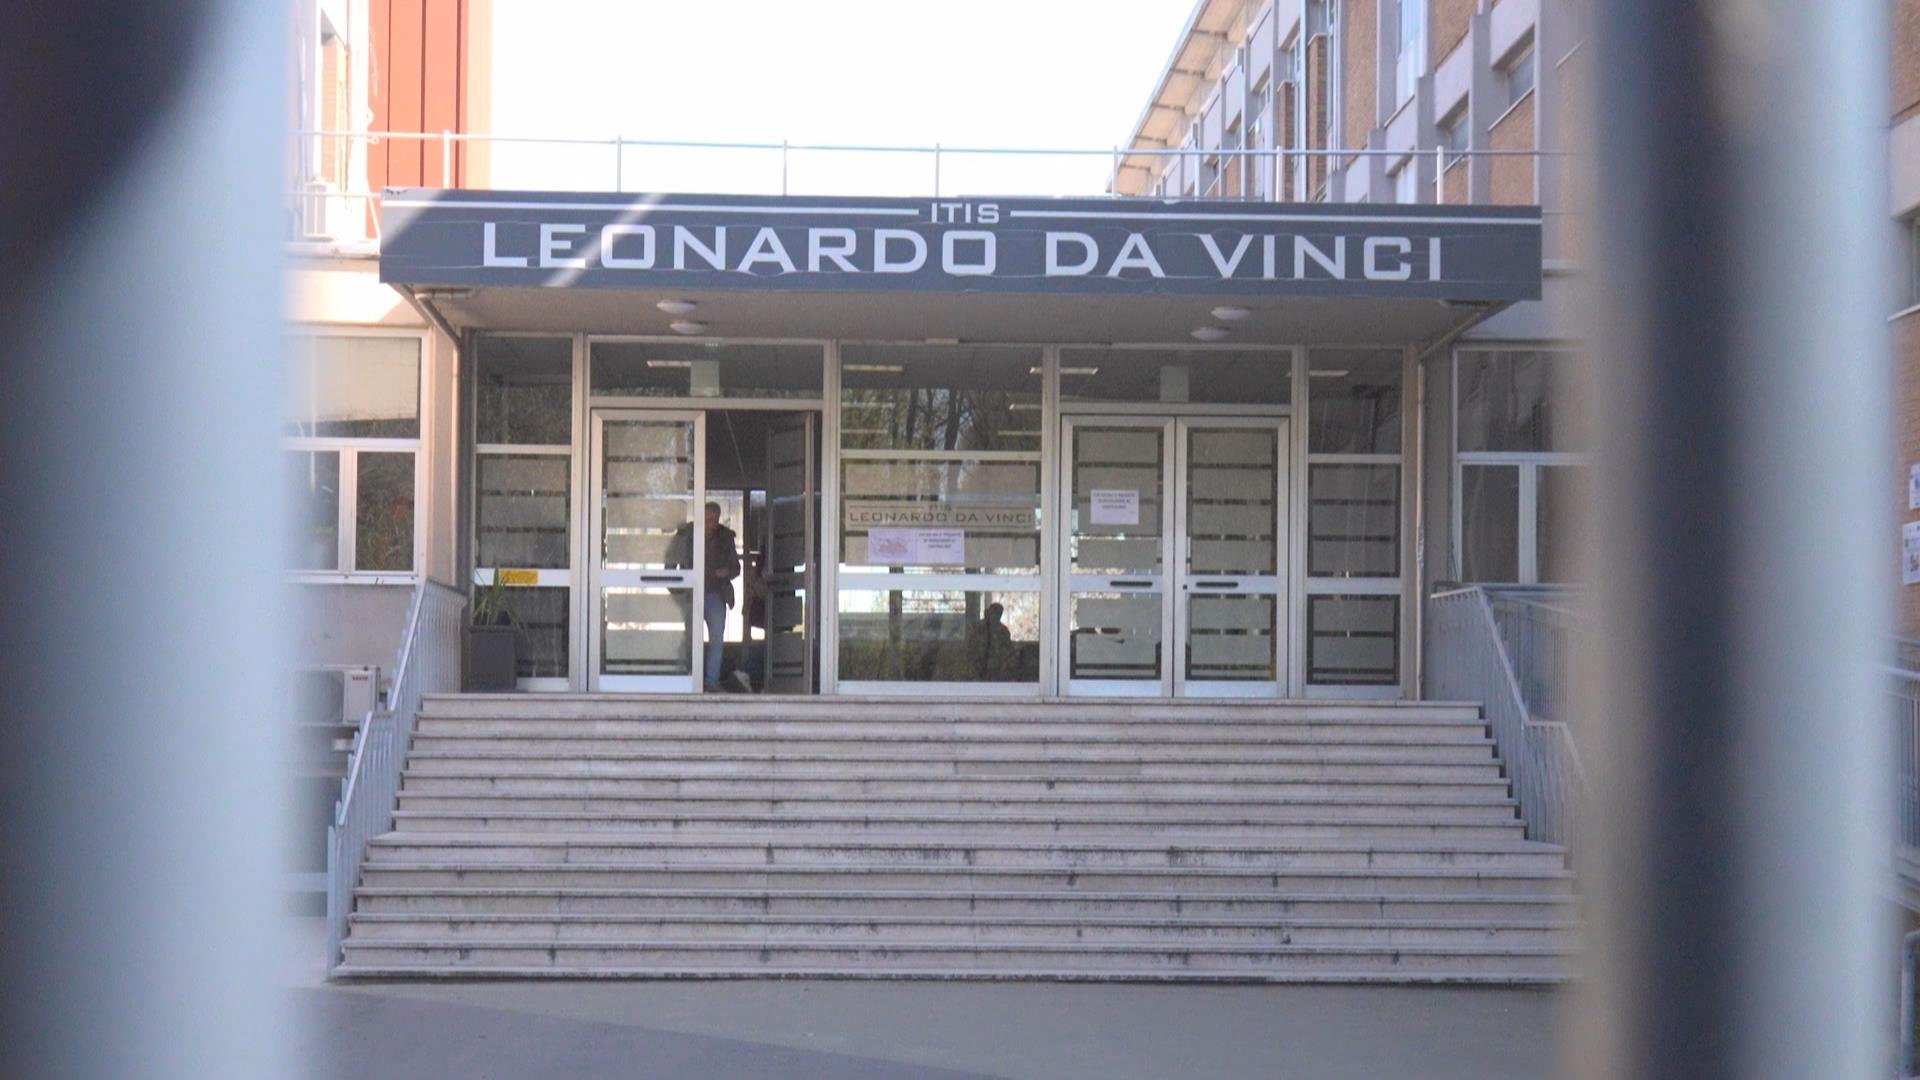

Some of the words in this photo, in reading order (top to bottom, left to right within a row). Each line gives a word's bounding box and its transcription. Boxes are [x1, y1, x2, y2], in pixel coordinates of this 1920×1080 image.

[931, 203, 999, 223] ITIS
[484, 222, 996, 275] LEONARDO
[1046, 231, 1166, 278] DA
[1198, 234, 1441, 281] VINCI
[850, 511, 947, 522] LEONARDO
[955, 512, 978, 522] DA
[985, 512, 1031, 523] VINCI
